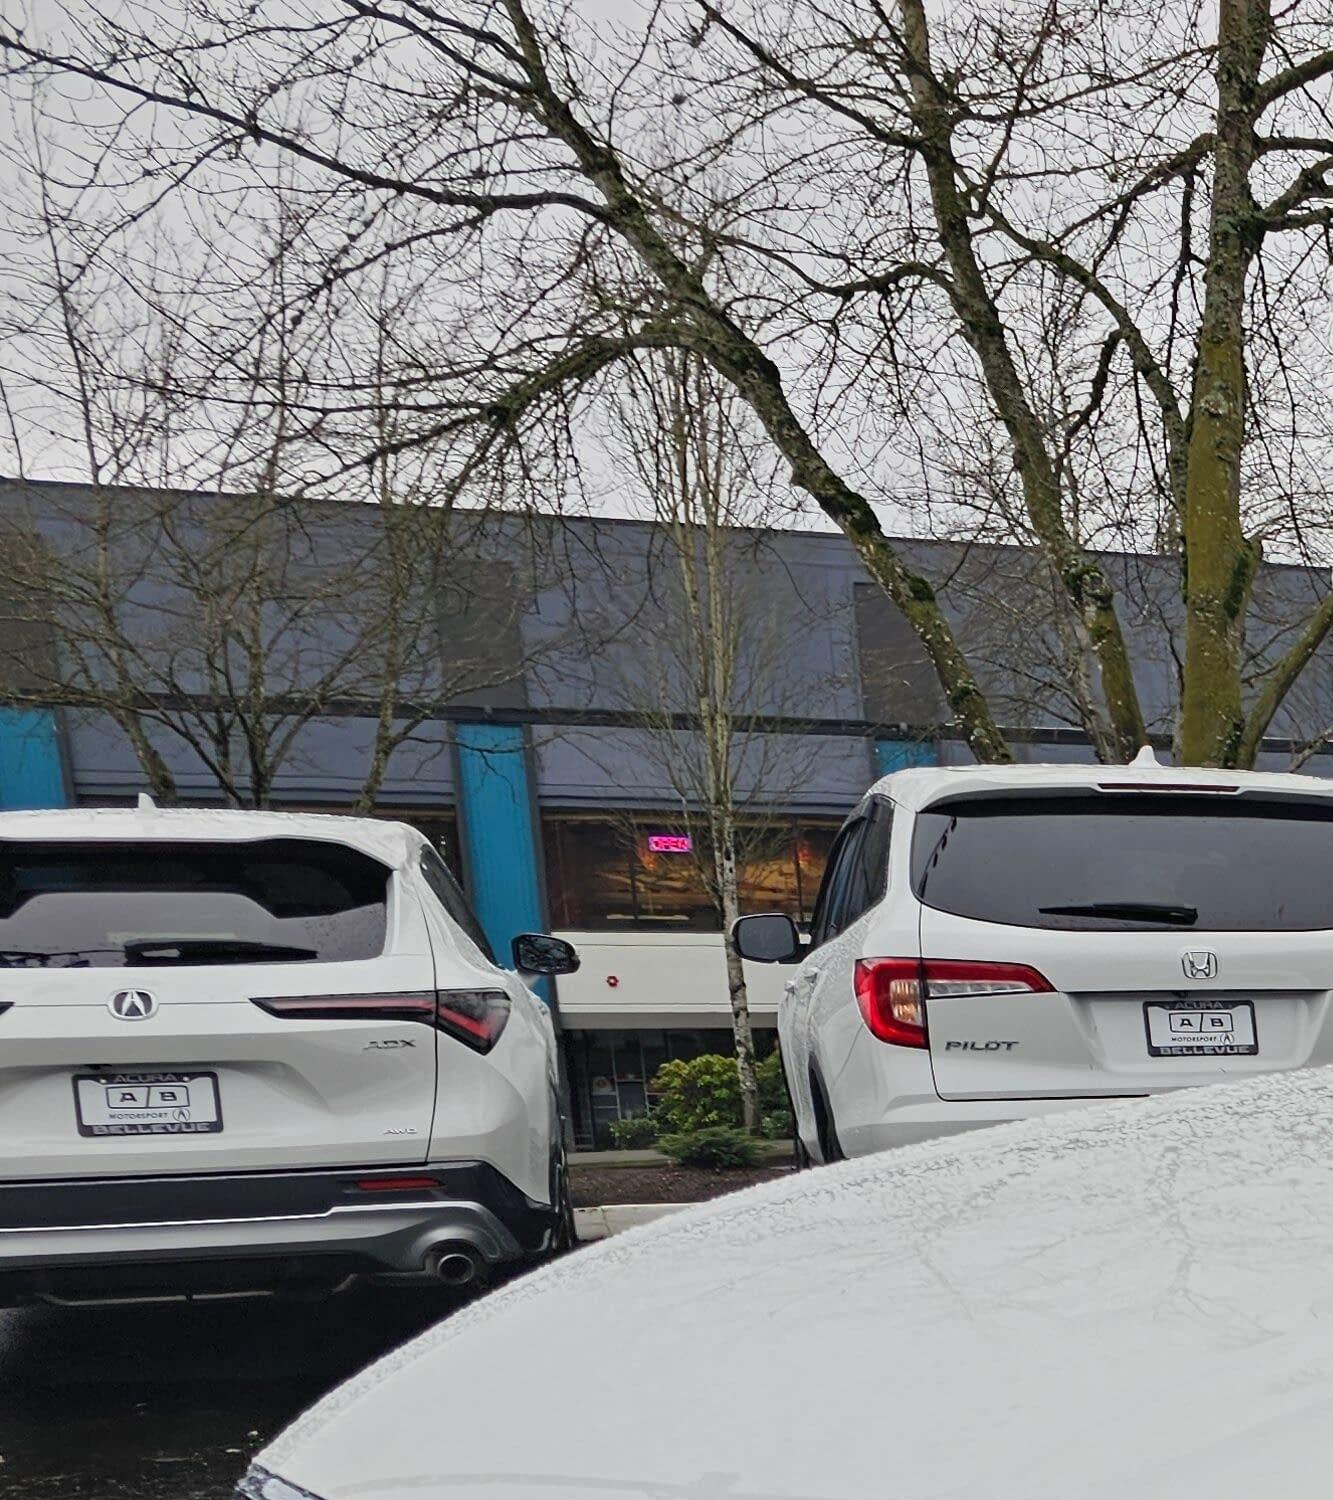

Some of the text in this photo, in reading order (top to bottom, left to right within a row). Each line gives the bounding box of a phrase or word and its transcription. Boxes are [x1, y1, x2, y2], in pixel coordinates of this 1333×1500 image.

[650, 837, 690, 851] OPEN
[1174, 1001, 1224, 1009] ACURA
[945, 1040, 1020, 1051] PILOT
[1159, 1046, 1250, 1055] BELLEVUE
[113, 1073, 178, 1083] ACURA
[108, 1112, 169, 1120] MOTORSPORT
[91, 1122, 211, 1135] BELLEVUE
